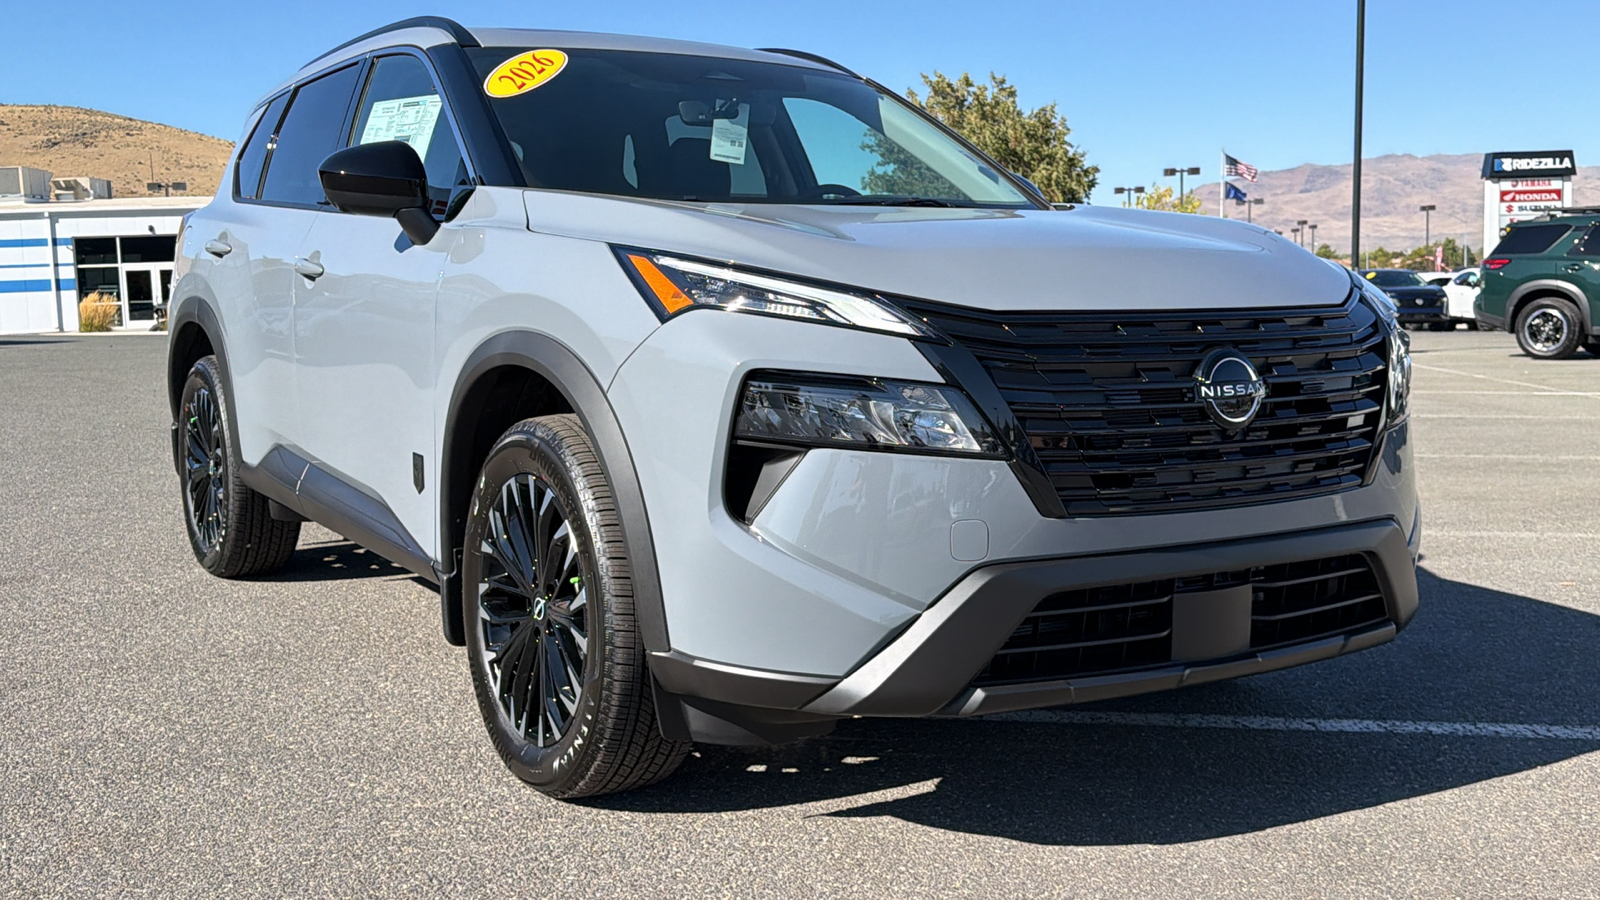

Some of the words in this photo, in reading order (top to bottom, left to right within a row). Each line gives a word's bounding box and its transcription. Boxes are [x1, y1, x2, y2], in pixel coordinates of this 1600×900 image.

[498, 53, 554, 90] 2026
[1513, 157, 1572, 169] RIDEZILLA
[1520, 179, 1551, 187] YAMAHA
[1515, 192, 1559, 201] HONDA
[1201, 381, 1264, 397] NISSAN
